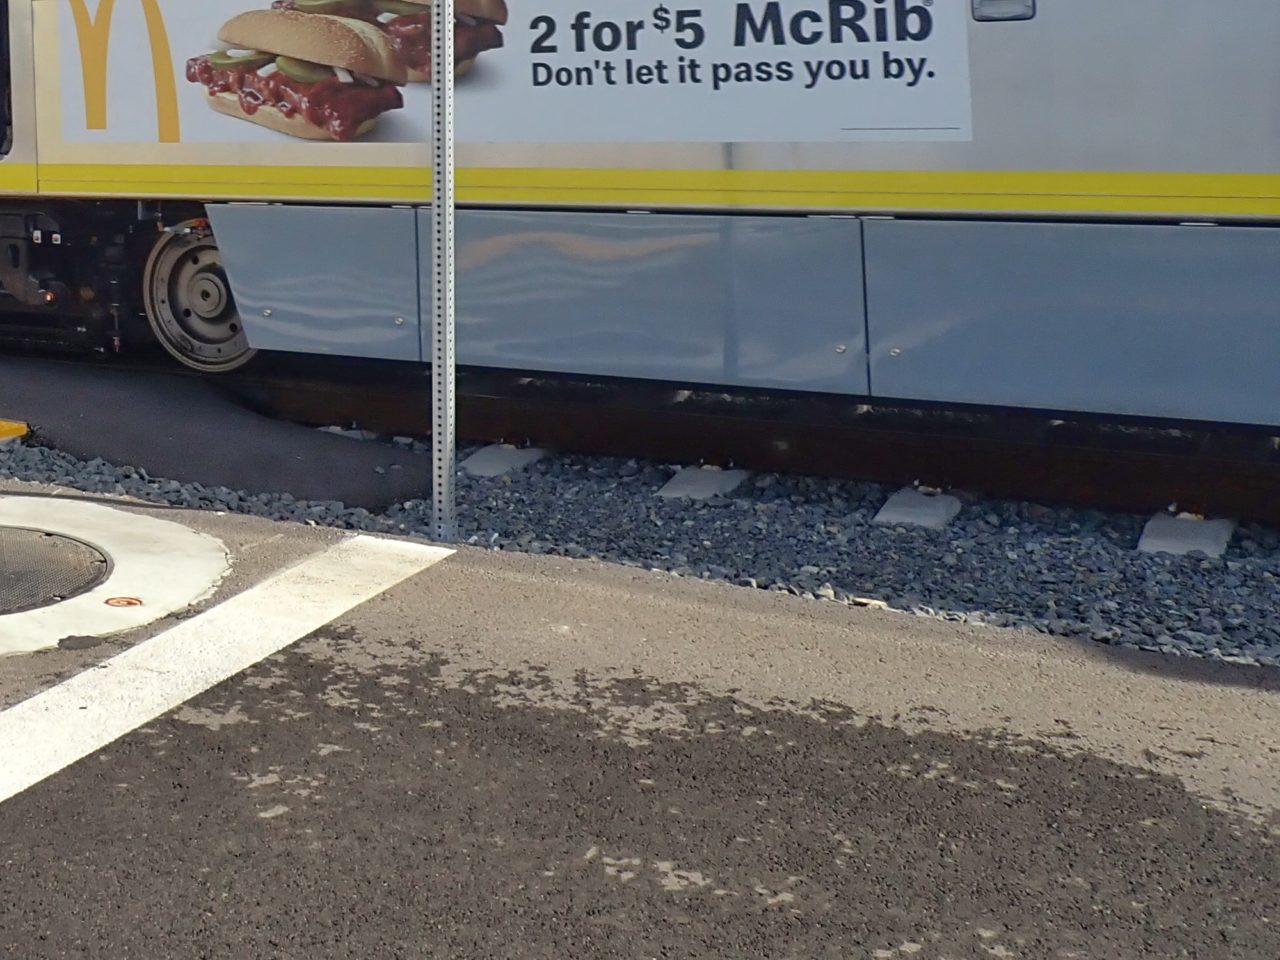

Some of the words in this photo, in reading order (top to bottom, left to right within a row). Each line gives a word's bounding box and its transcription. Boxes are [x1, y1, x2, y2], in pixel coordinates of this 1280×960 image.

[529, 15, 558, 53] 2
[570, 11, 645, 52] for
[652, 3, 705, 50] $5
[532, 59, 617, 87] Don't
[625, 58, 669, 85] let
[678, 55, 702, 84] it
[712, 59, 794, 91] pass
[804, 57, 870, 89] you
[882, 51, 936, 87] by.
